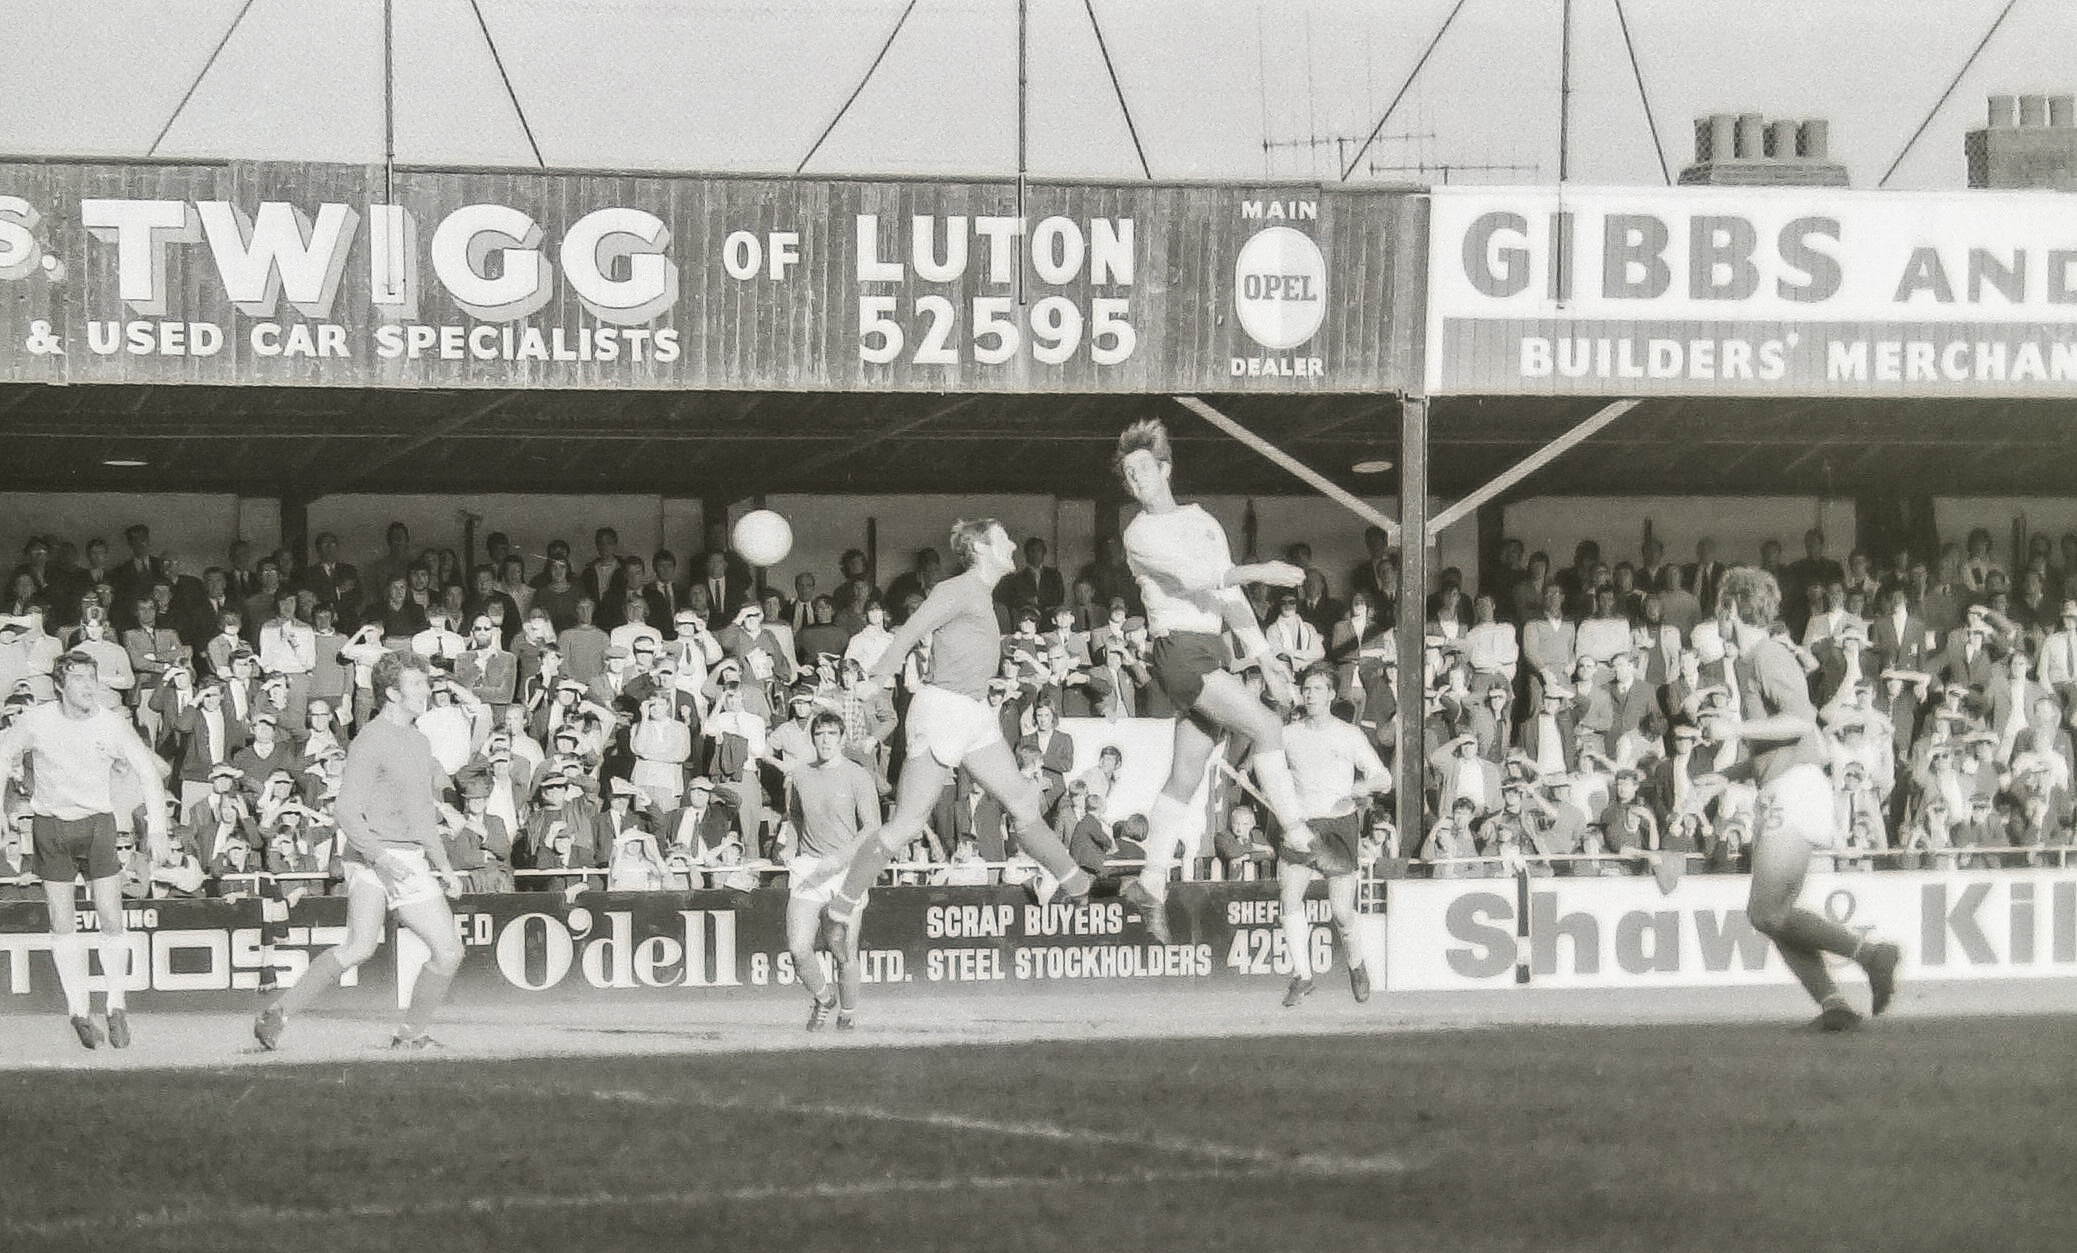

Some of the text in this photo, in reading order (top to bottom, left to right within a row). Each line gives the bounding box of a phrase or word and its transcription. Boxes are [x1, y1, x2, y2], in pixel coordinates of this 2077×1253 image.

[1241, 200, 1318, 220] MAIN
[82, 199, 680, 323] TWIGG
[723, 231, 800, 281] OF
[856, 214, 1136, 286] LUTON
[1461, 211, 1844, 303] GIBBS
[1244, 274, 1317, 302] OPEL
[26, 319, 681, 363] & USED CAR SPECIALISTS
[857, 296, 1137, 366] 52595
[1231, 357, 1324, 377] DEALER
[1520, 332, 1799, 380] BUILDERS'
[74, 908, 158, 930] EVING
[927, 904, 1014, 938] SCRAP
[1024, 903, 1123, 935] BUYERS
[1227, 900, 1332, 925] SHEFRD
[1445, 890, 1772, 978] Shaw
[1921, 881, 2077, 965] Kil
[496, 908, 744, 990] O'dell
[751, 952, 770, 985] &
[859, 949, 913, 983] LTD.
[927, 944, 1213, 982] STEEL STOCKHOLDERS
[1227, 927, 1332, 975] 4256
